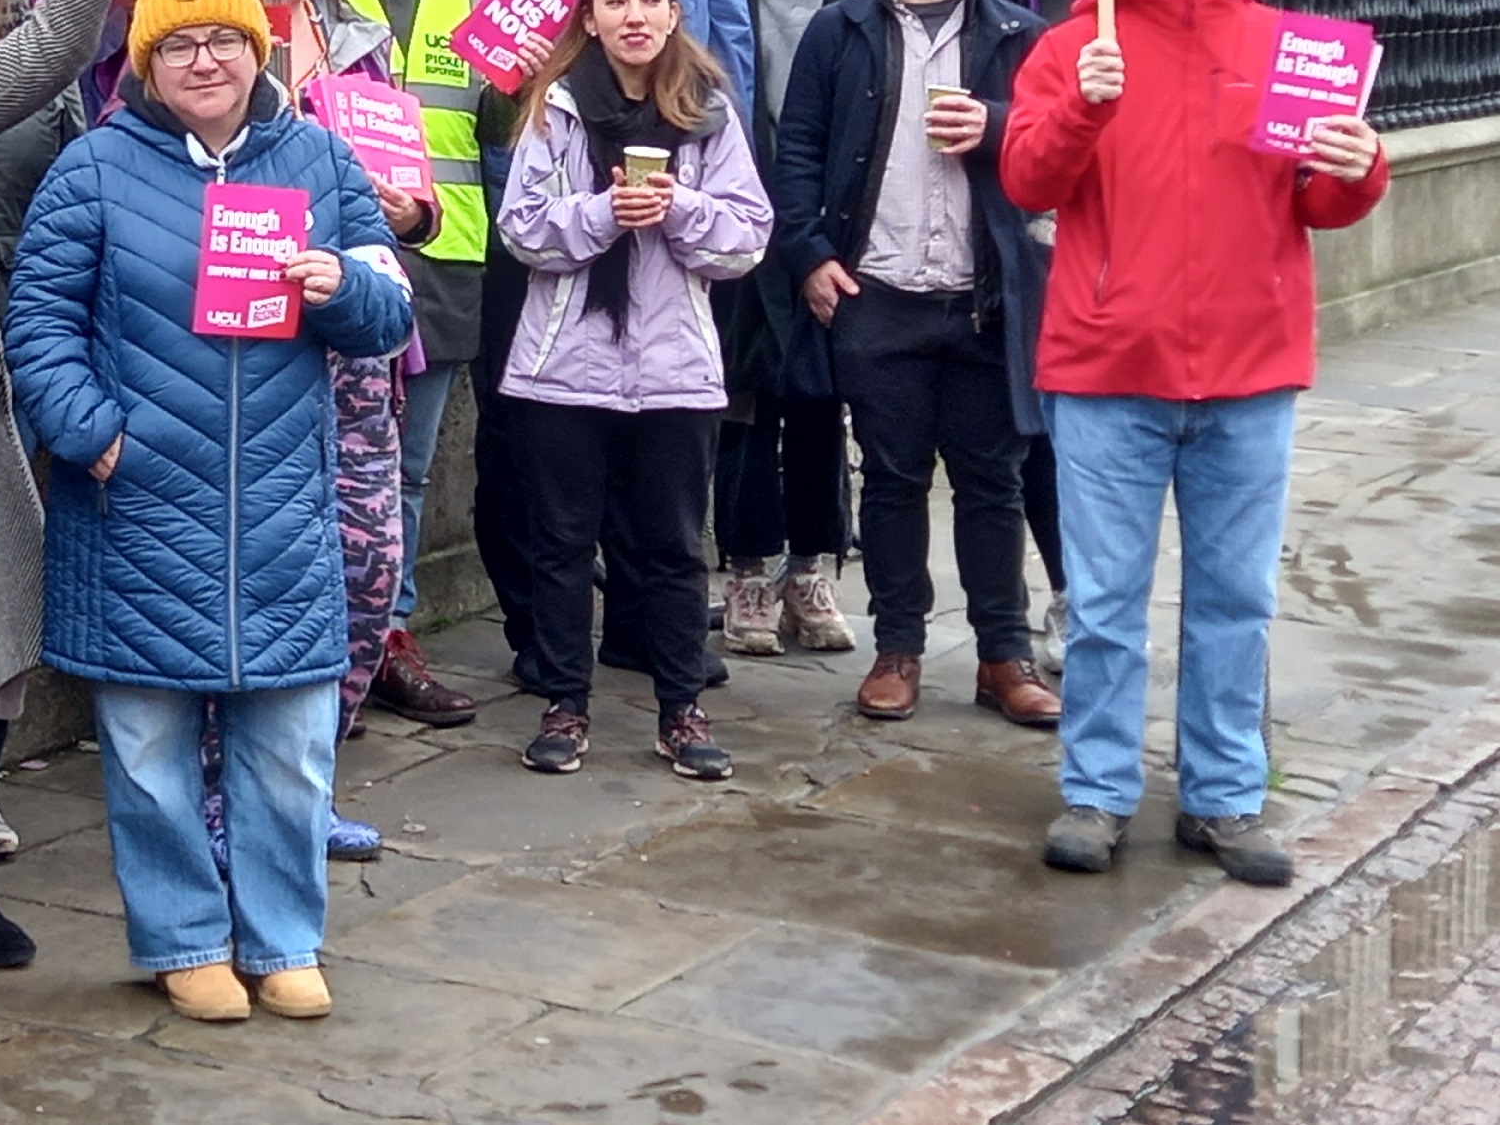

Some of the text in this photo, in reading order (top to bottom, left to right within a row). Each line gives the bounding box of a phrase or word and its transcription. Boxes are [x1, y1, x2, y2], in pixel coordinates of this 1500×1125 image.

[425, 34, 451, 49] UC
[1280, 31, 1345, 63] Enough
[1275, 52, 1359, 87] is Enough
[366, 112, 421, 143] Enough
[212, 204, 280, 236] Enough
[210, 230, 298, 263] is Enough
[207, 310, 242, 325] UCU
